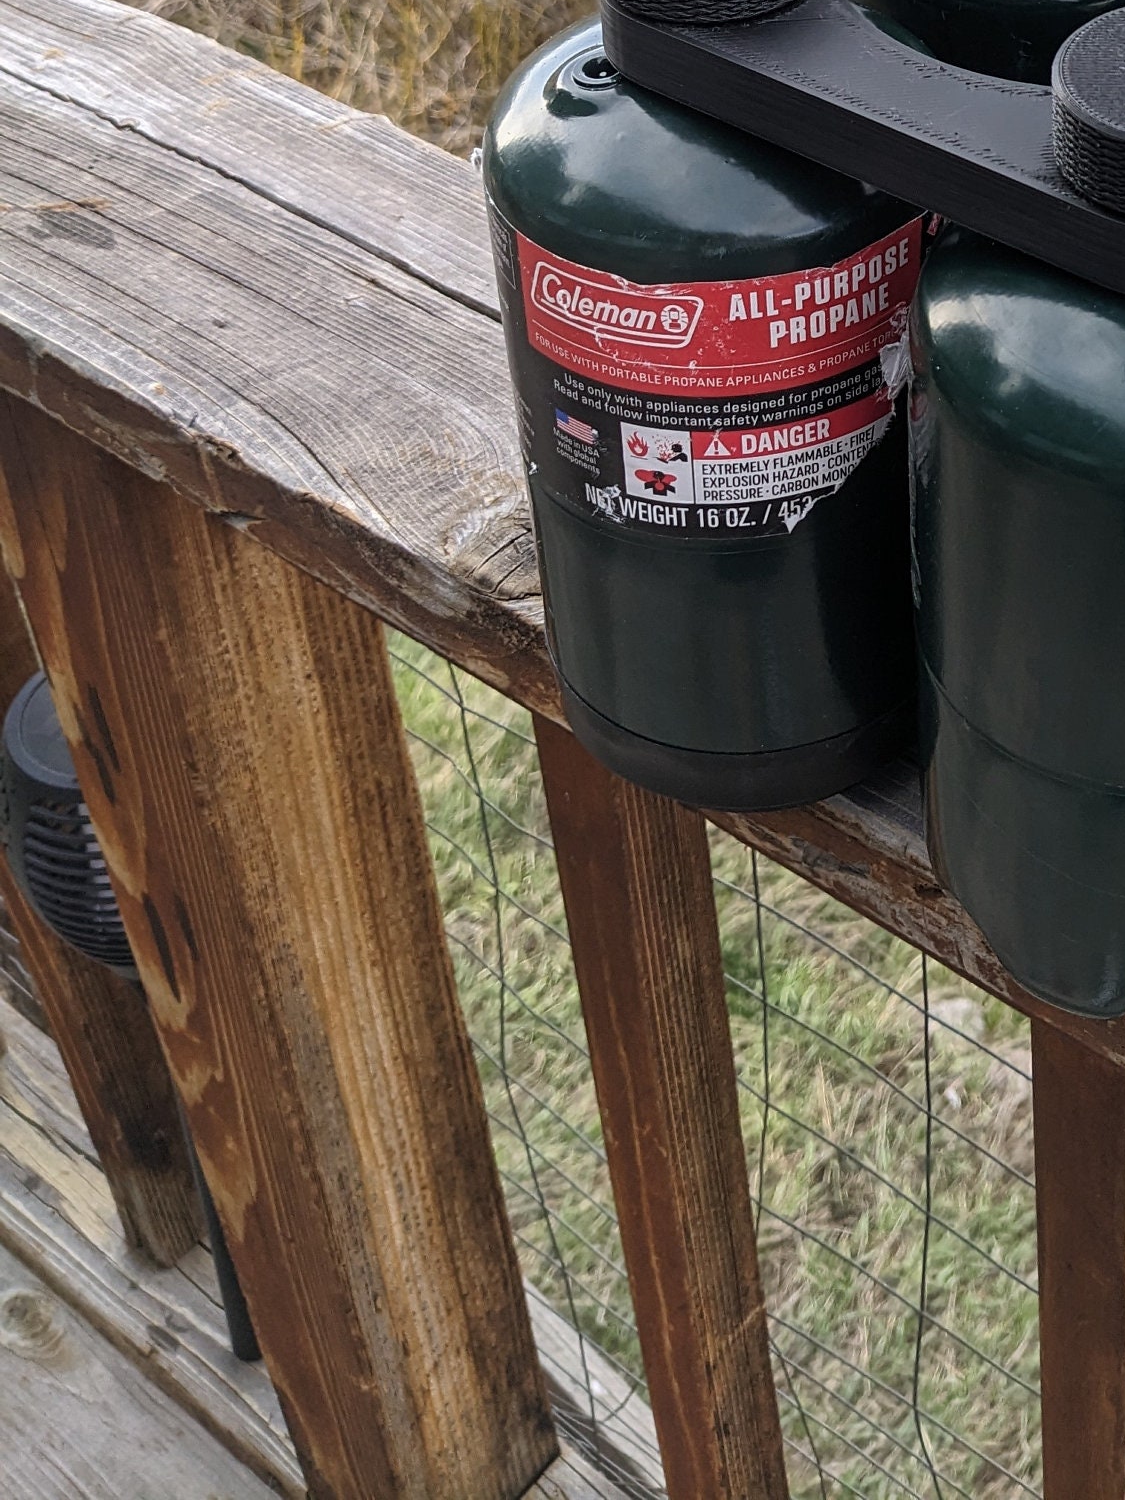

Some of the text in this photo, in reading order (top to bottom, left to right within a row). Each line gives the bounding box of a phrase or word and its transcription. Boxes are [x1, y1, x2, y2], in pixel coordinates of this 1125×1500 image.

[541, 273, 658, 331] Coleman
[729, 237, 909, 322] ALL-PURPOSE
[769, 281, 889, 349] PROPANE
[535, 331, 551, 348] FOR
[552, 343, 570, 360] USE
[571, 352, 599, 373] WITH
[601, 364, 662, 385] PORTABLE
[664, 376, 724, 389] PROPANE
[726, 366, 805, 388] APPLIANCES
[807, 361, 817, 374] &
[819, 343, 870, 370] PROPANE
[553, 378, 579, 400] Read
[581, 394, 602, 411] and
[604, 401, 643, 420] follow
[646, 411, 712, 428] important
[715, 414, 758, 427] safety
[762, 400, 824, 423] warnings
[827, 395, 842, 408] on
[845, 383, 869, 404] side
[564, 372, 585, 391] Use
[588, 384, 612, 403] only
[614, 392, 643, 409] with
[646, 400, 719, 417] appliances
[723, 392, 785, 414] designed
[789, 391, 804, 404] for
[811, 374, 862, 403] propane
[552, 426, 600, 458] Made in USA
[573, 449, 597, 465] global
[702, 424, 876, 476] EXTREMELY FLAMMABLE FIRE/
[741, 417, 830, 455] DANGER
[556, 446, 600, 475] components
[702, 474, 770, 489] EXPLOSION
[772, 462, 820, 483] HAZARD
[703, 462, 857, 502] PRESSURE CARBON MONO
[585, 482, 614, 514] NET
[618, 494, 689, 528] WEIGHT
[697, 507, 720, 529] 16
[725, 506, 757, 528] OZ.
[762, 503, 772, 525] /
